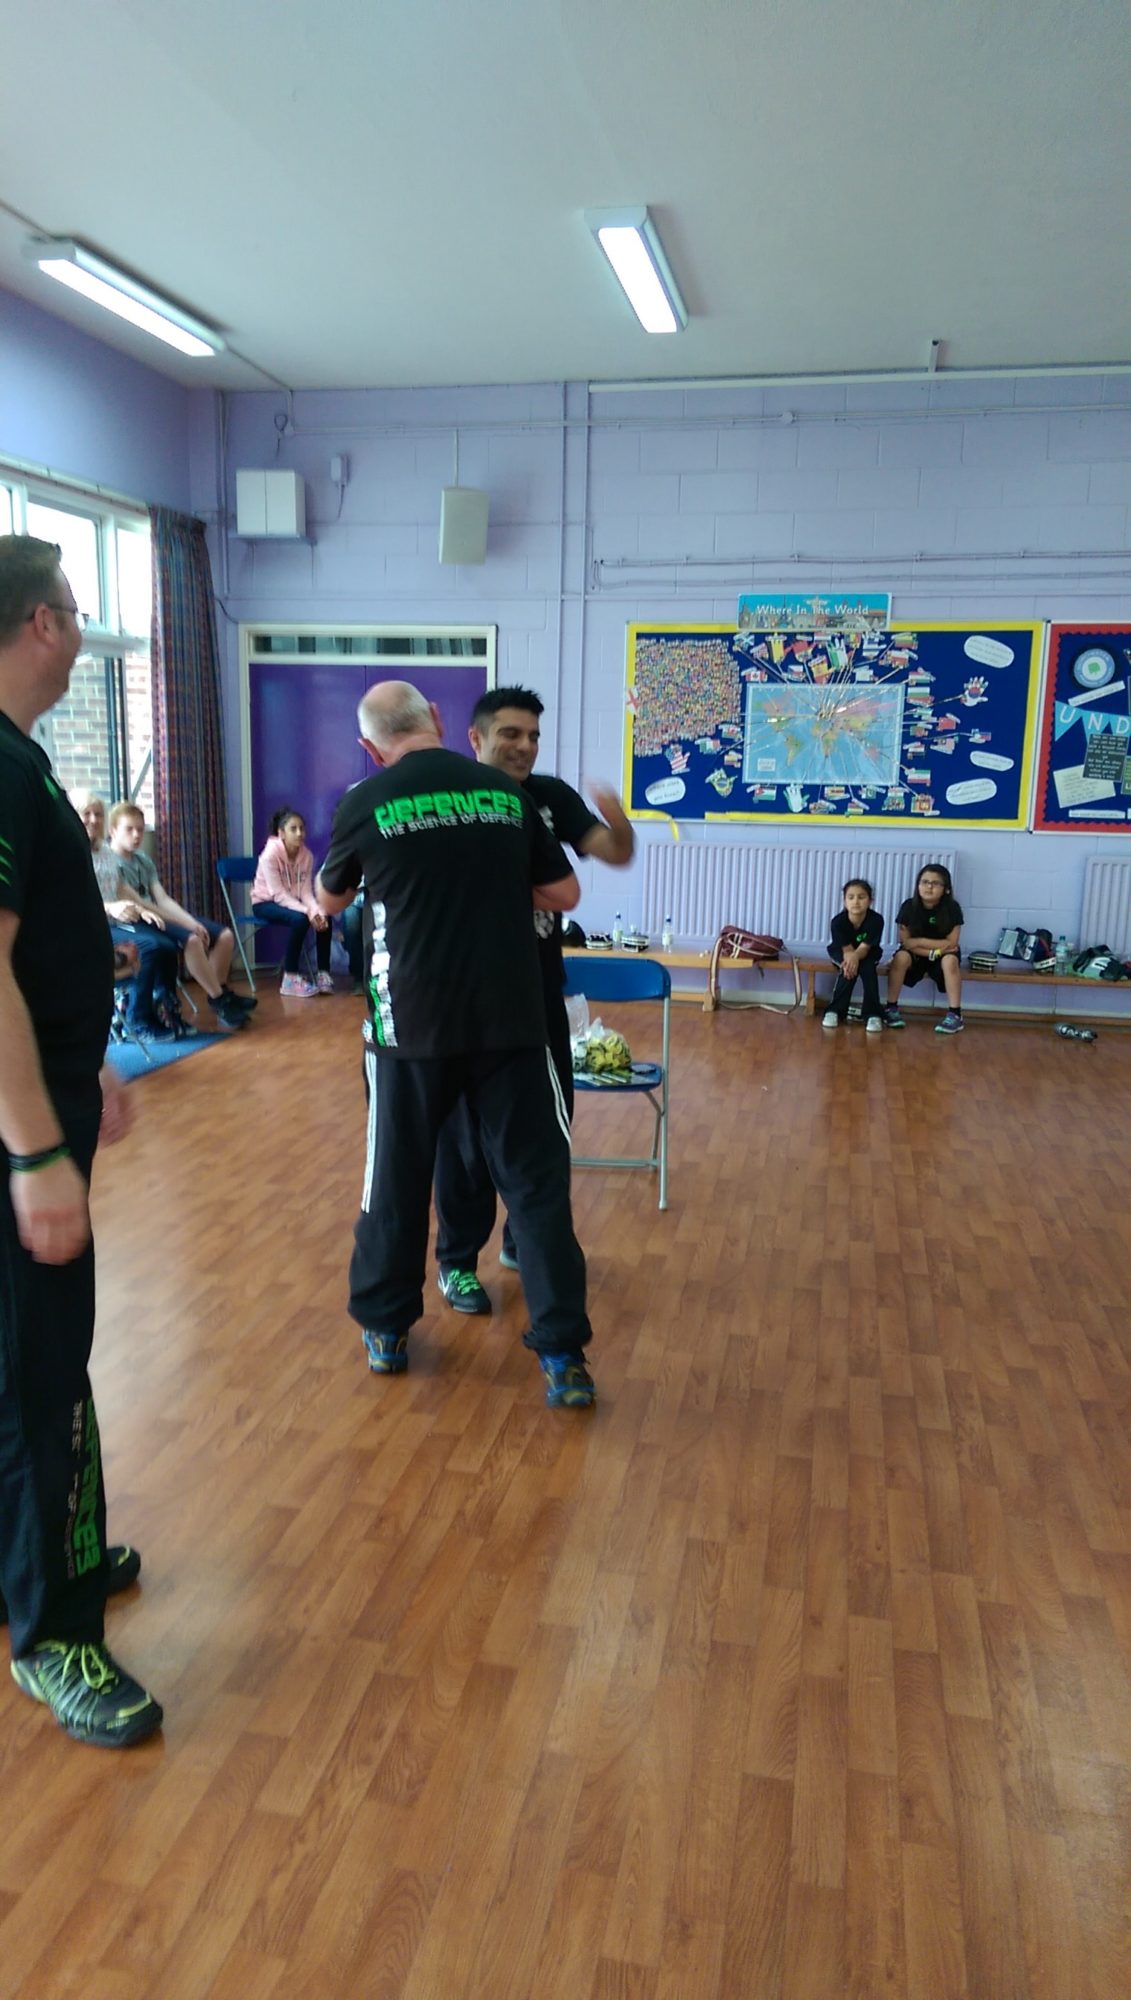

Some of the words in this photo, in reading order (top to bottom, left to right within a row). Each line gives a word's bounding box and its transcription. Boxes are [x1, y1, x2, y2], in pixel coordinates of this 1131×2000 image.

[757, 604, 792, 615] Where
[796, 604, 807, 615] In
[811, 604, 830, 615] The
[834, 604, 869, 615] World
[379, 824, 406, 840] THE
[408, 815, 459, 833] SCIENCE
[459, 813, 478, 824] OF
